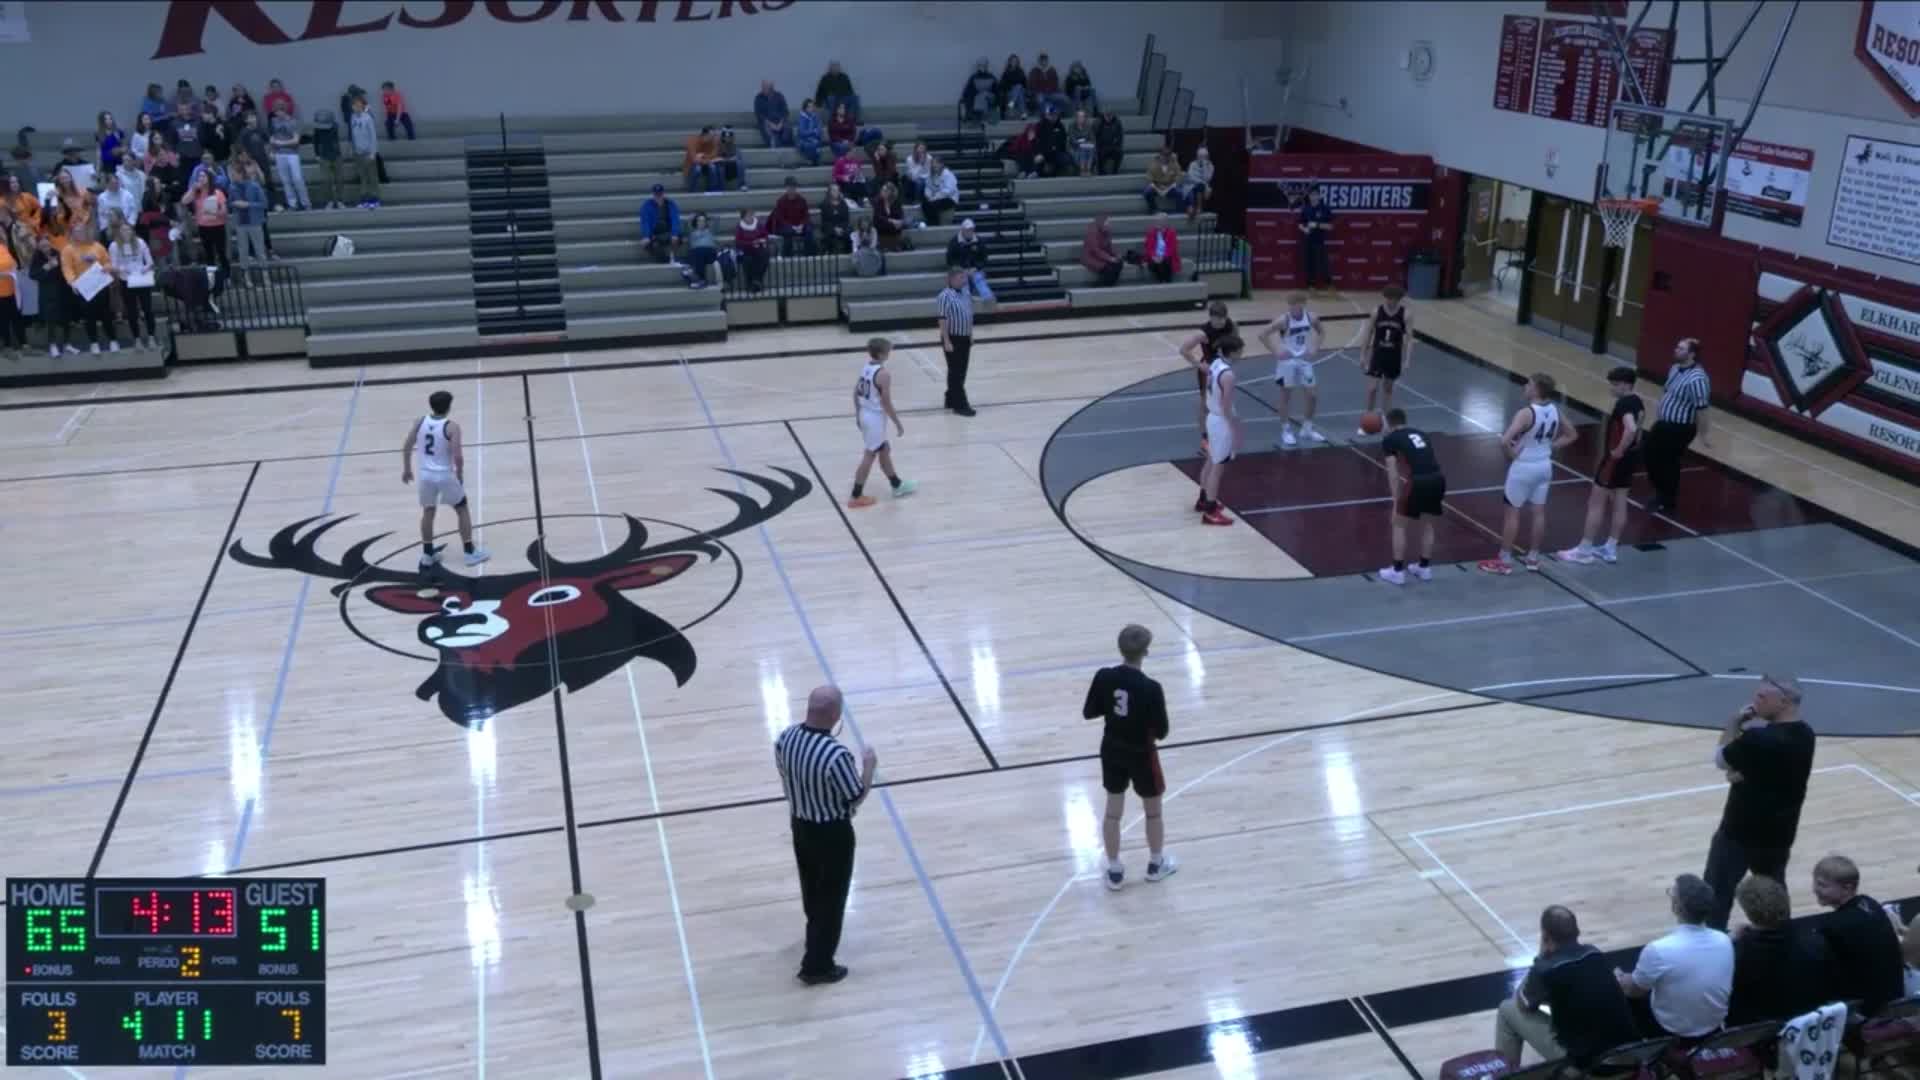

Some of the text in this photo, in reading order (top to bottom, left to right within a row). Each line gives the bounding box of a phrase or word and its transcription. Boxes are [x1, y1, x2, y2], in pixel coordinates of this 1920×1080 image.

[1319, 185, 1413, 207] RESORTERS
[1408, 433, 1427, 449] 2
[1533, 421, 1558, 443] 44
[425, 433, 435, 456] 2
[1113, 689, 1129, 717] 3
